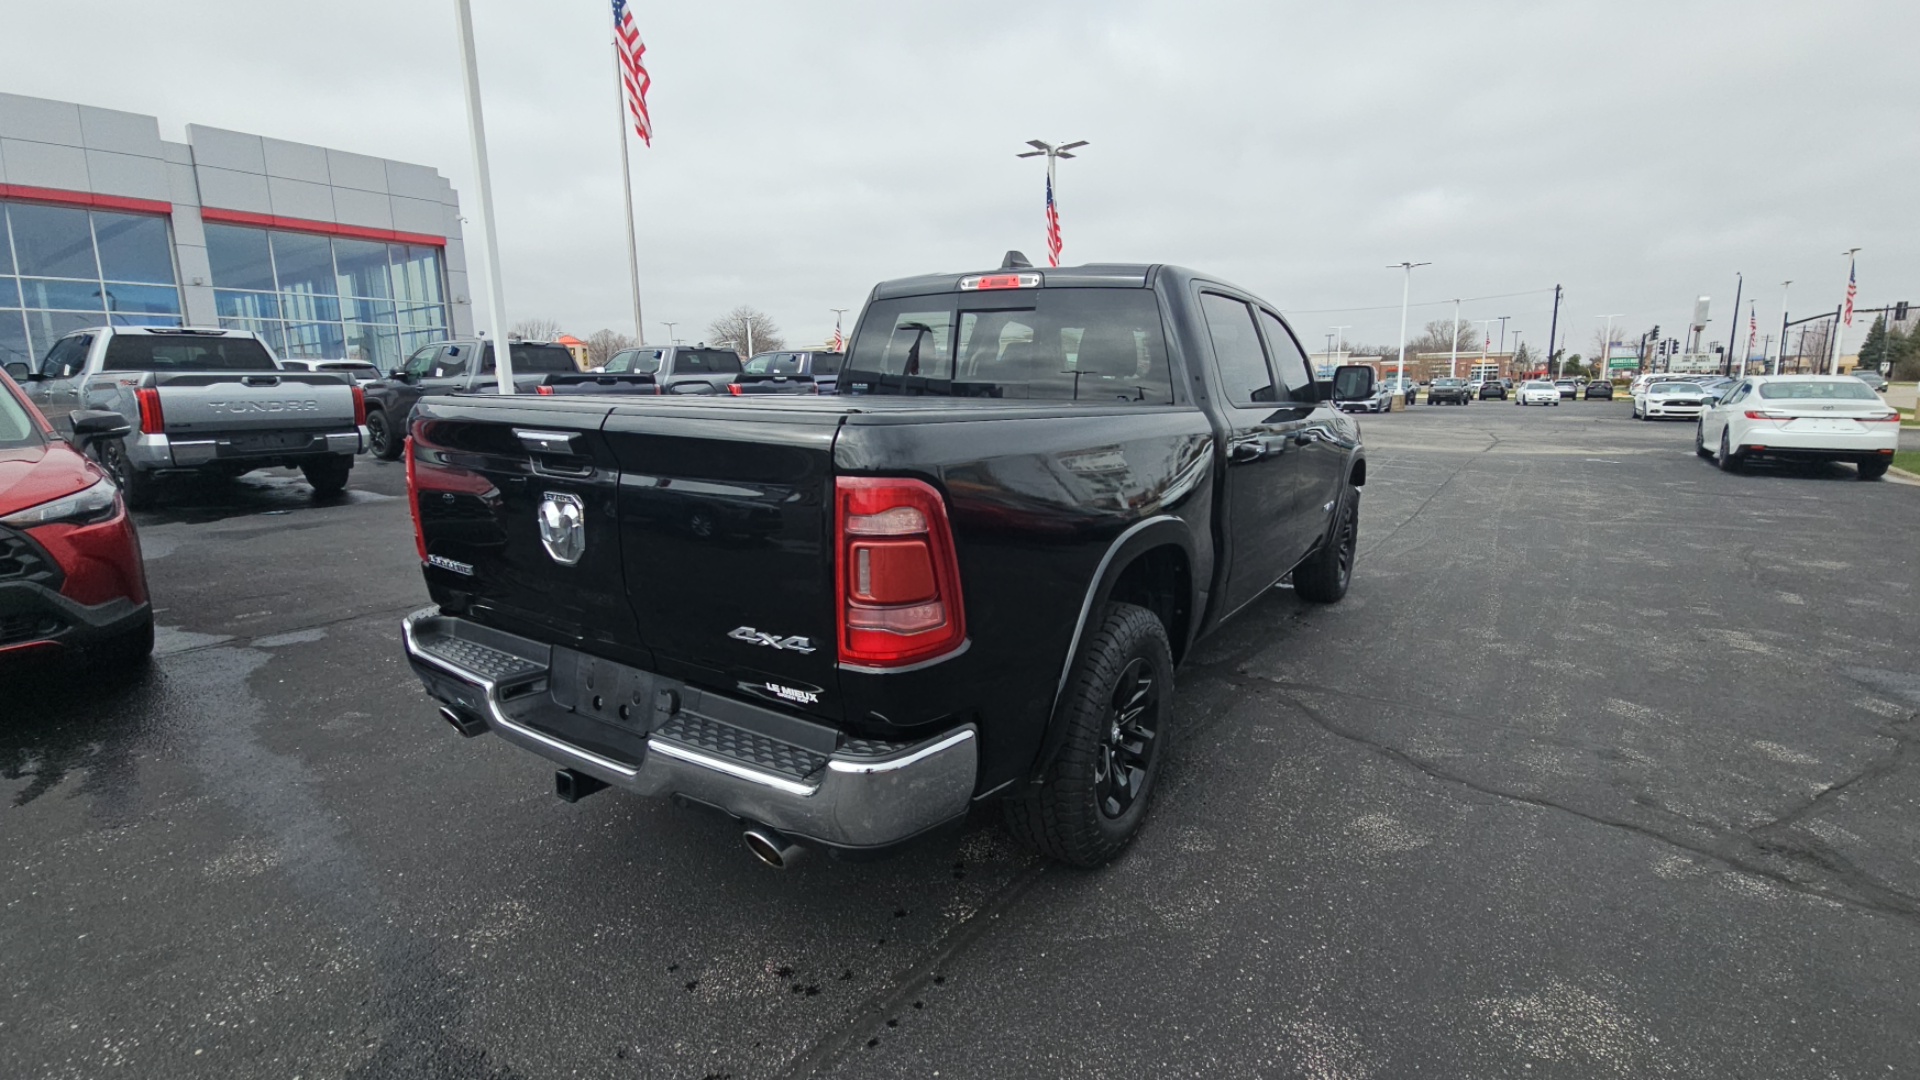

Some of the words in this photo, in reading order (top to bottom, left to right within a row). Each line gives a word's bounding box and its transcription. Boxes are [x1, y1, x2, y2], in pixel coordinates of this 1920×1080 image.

[208, 400, 319, 414] TUNDRA
[766, 682, 780, 692] LE
[781, 686, 819, 703] MIEUX
